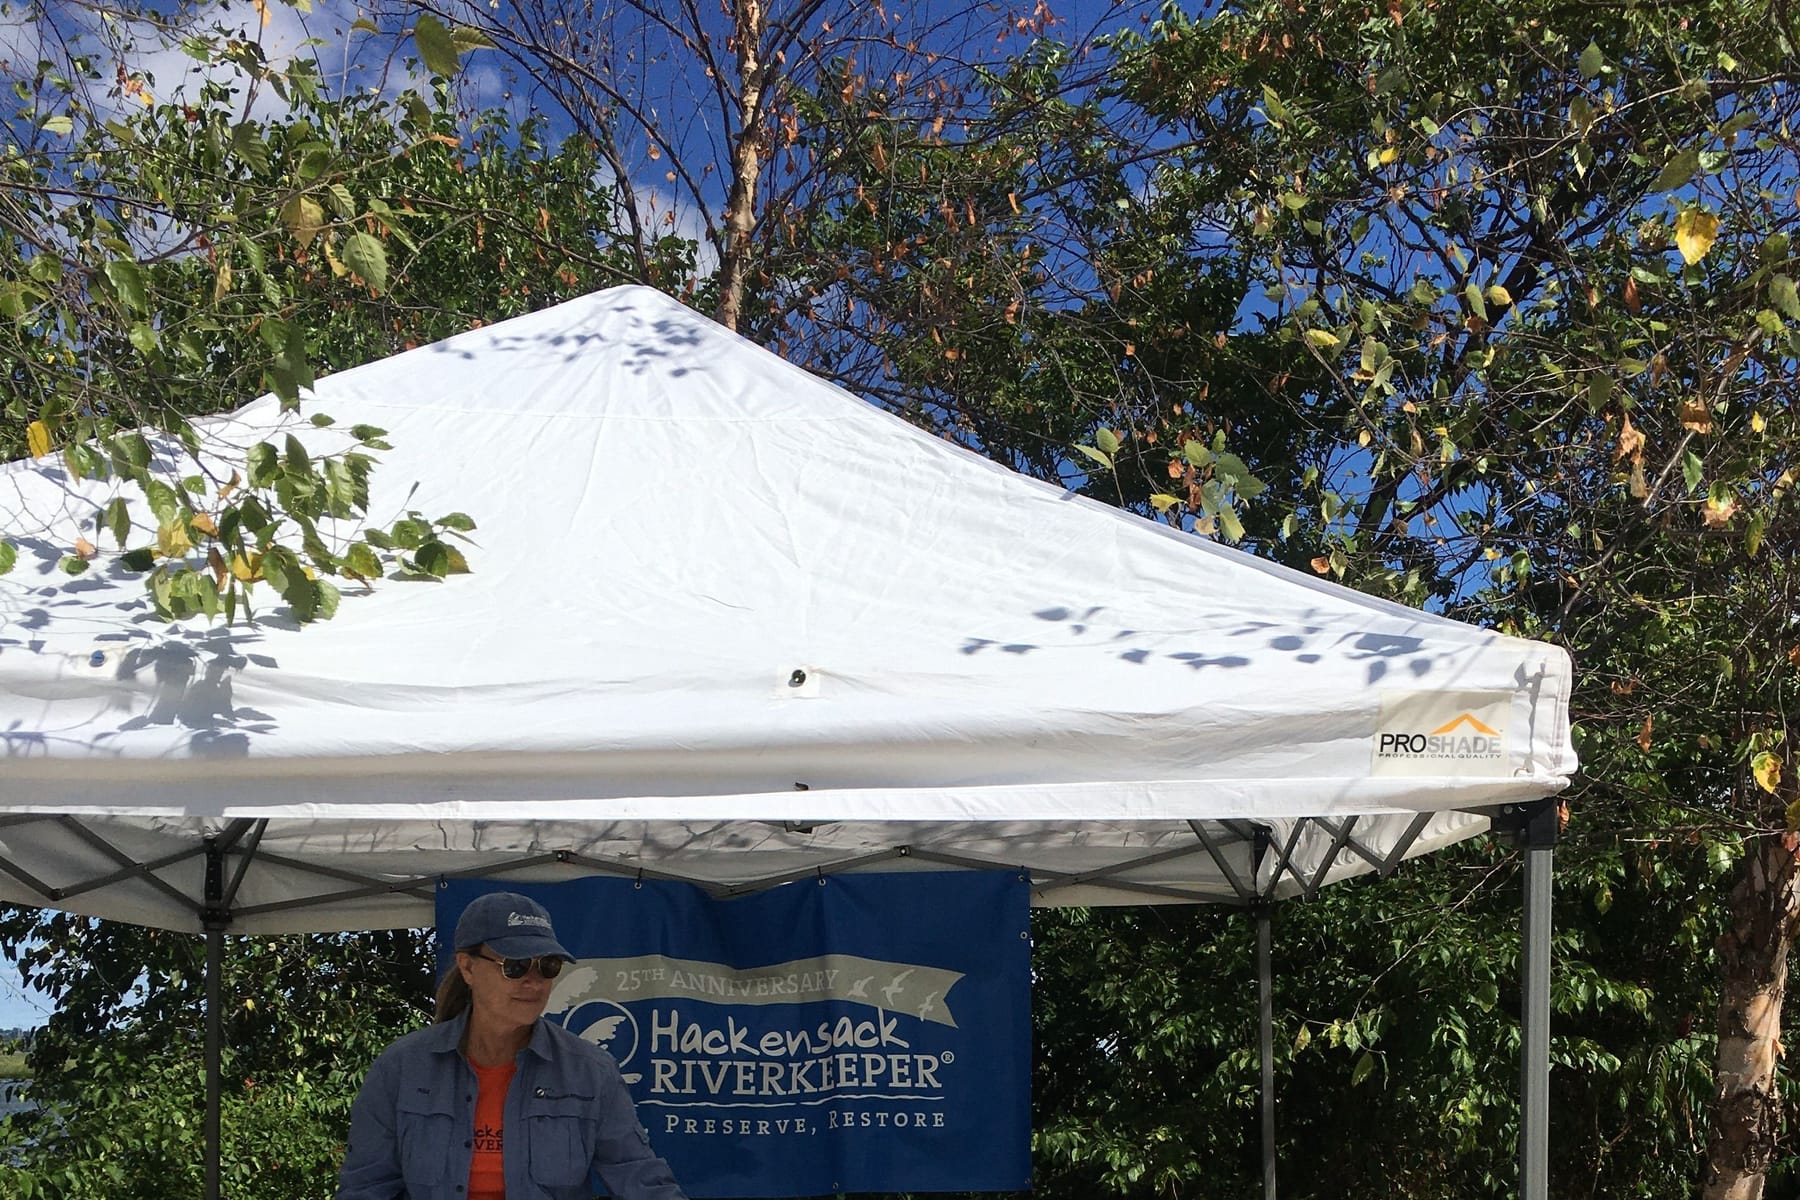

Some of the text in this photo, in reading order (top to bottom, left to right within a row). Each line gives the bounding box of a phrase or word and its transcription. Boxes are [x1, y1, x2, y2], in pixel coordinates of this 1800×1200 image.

[1380, 734, 1502, 753] PROSHADE
[616, 968, 839, 997] 25TH ANNIVERSARY
[651, 1008, 910, 1057] Hackensack
